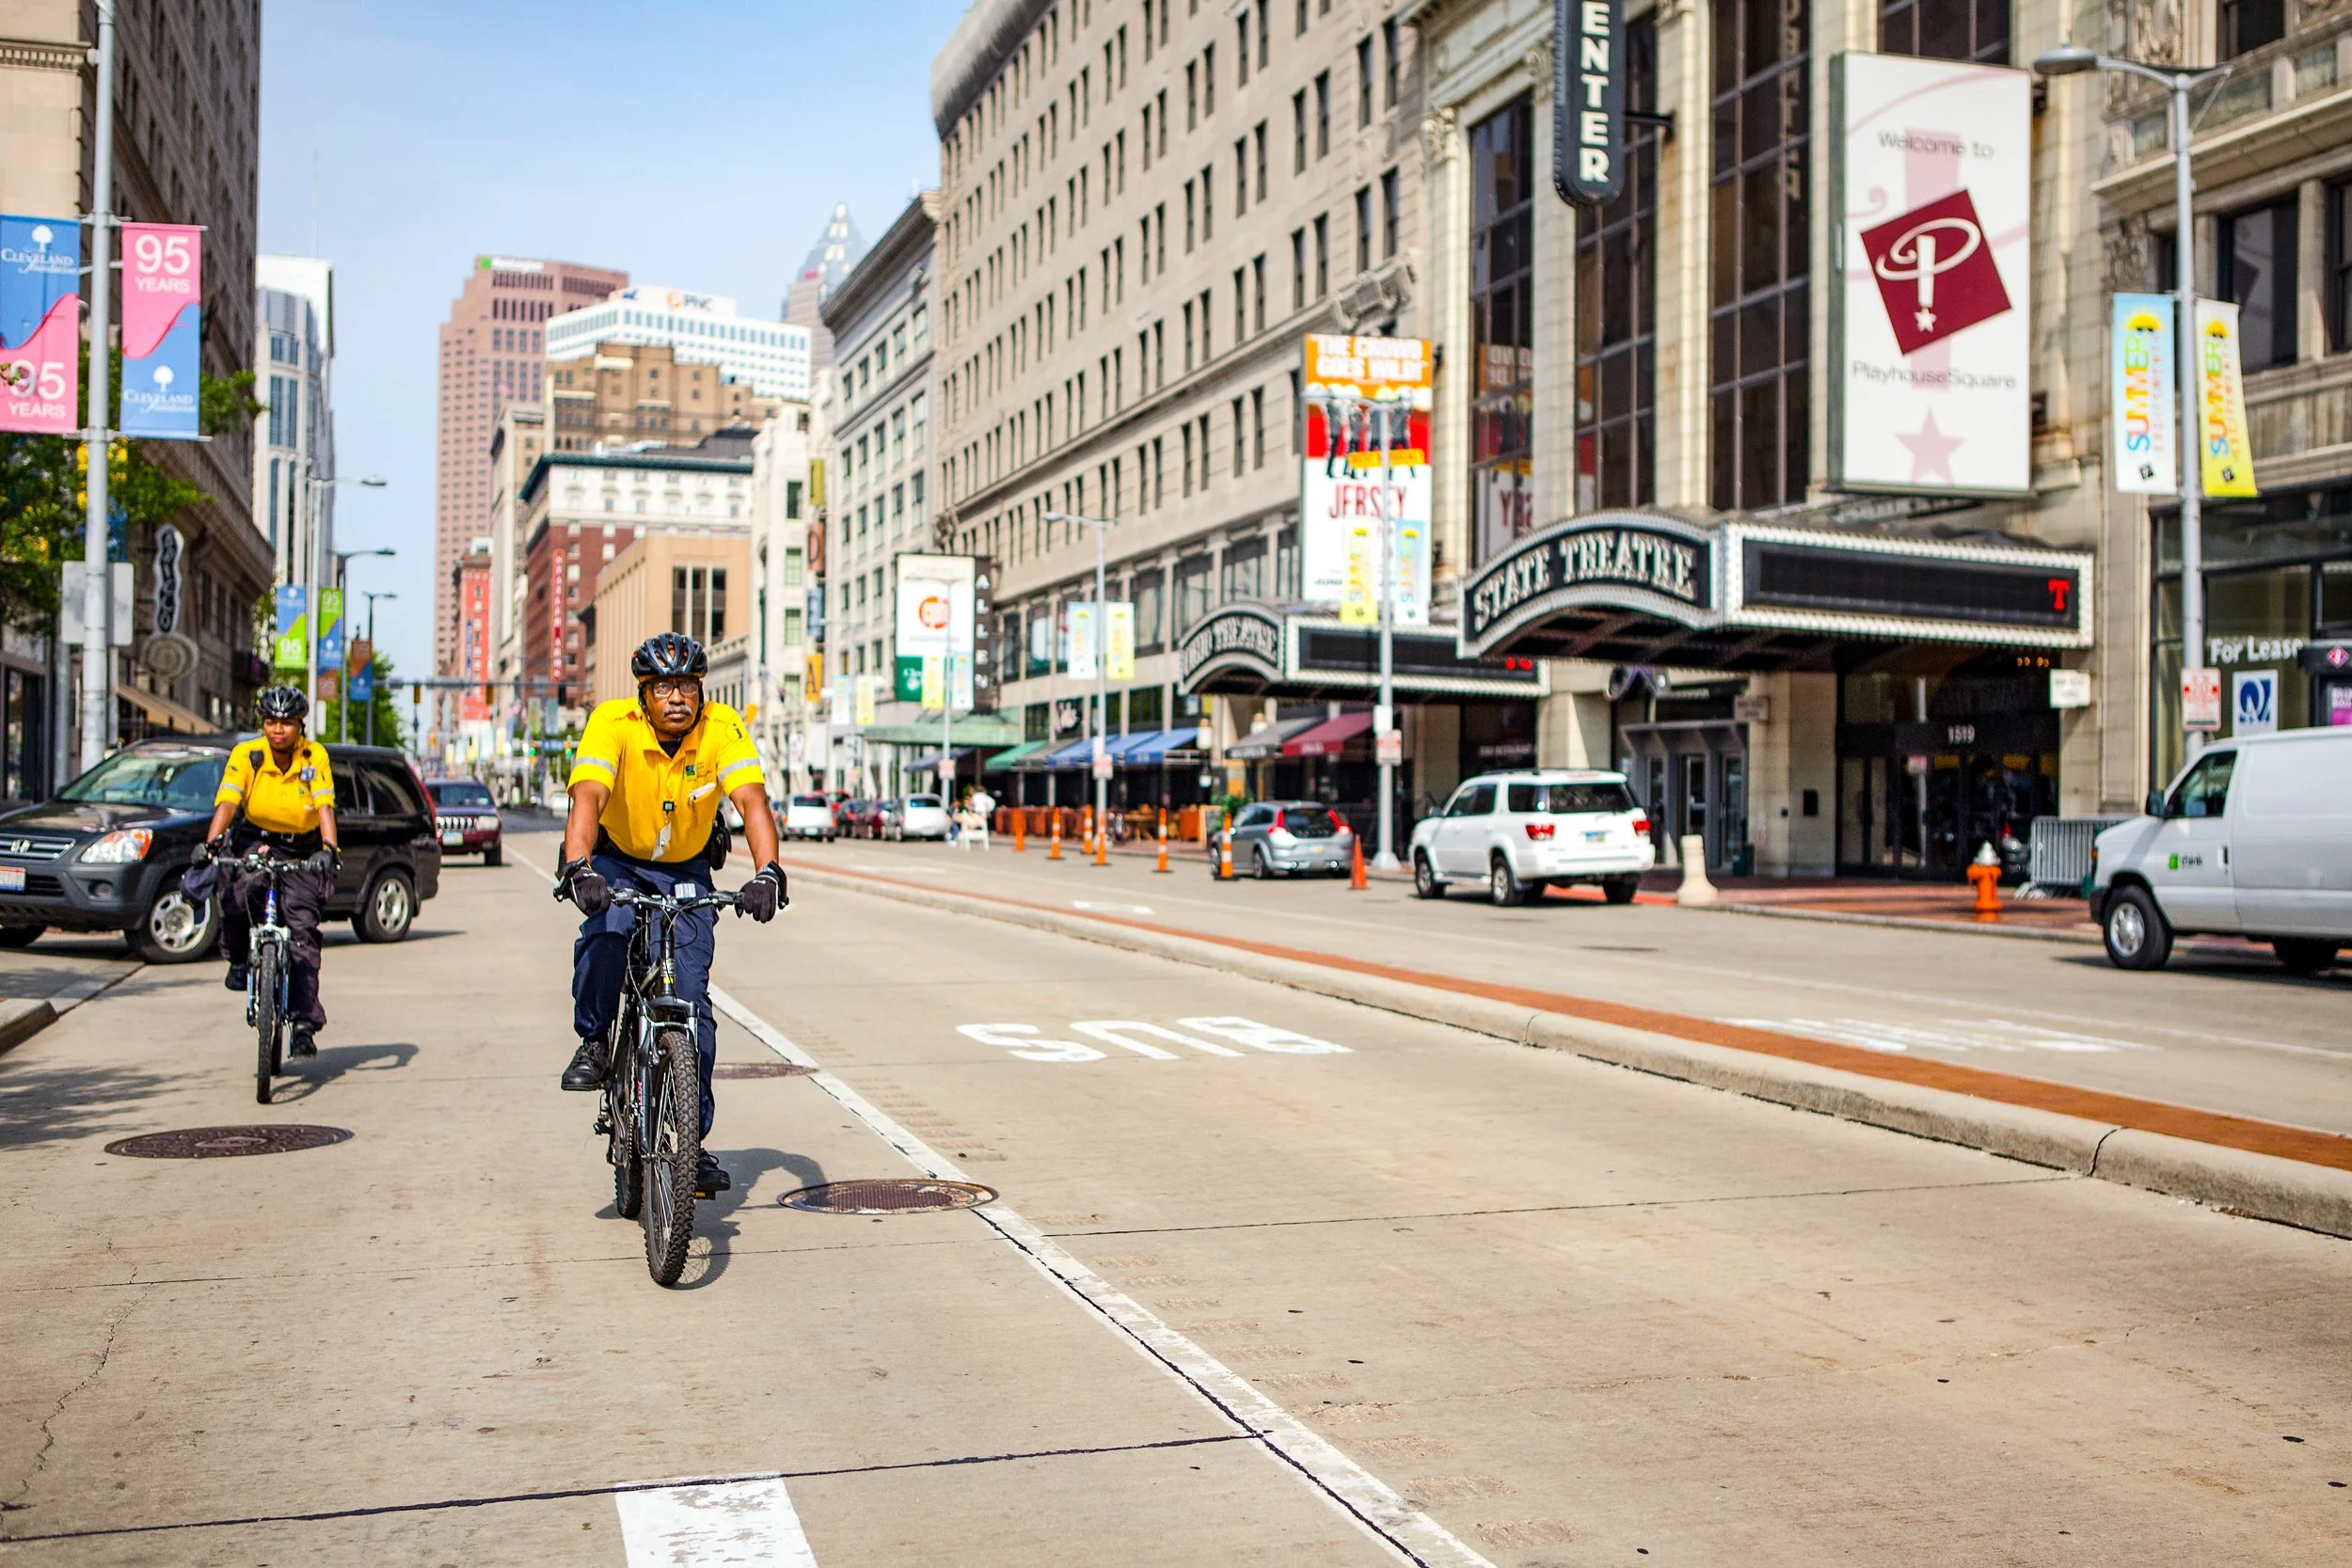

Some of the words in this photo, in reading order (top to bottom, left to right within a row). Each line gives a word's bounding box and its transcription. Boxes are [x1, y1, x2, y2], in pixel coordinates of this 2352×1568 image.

[1877, 130, 1966, 155] Welcome
[1972, 140, 1994, 160] to
[135, 234, 191, 276] 95
[135, 277, 191, 294] YEARS
[9, 358, 67, 401] 95
[2124, 335, 2151, 451] SUMMER
[2205, 340, 2230, 456] SUMMER
[8, 401, 66, 420] YEARS
[1328, 483, 1407, 518] JERSY
[1473, 544, 1550, 632] STATE
[1559, 530, 1696, 599] THEATRE
[2048, 578, 2070, 611] T
[975, 574, 990, 689] ALLEN
[2212, 638, 2243, 664] For
[955, 1016, 1356, 1062] BUS
